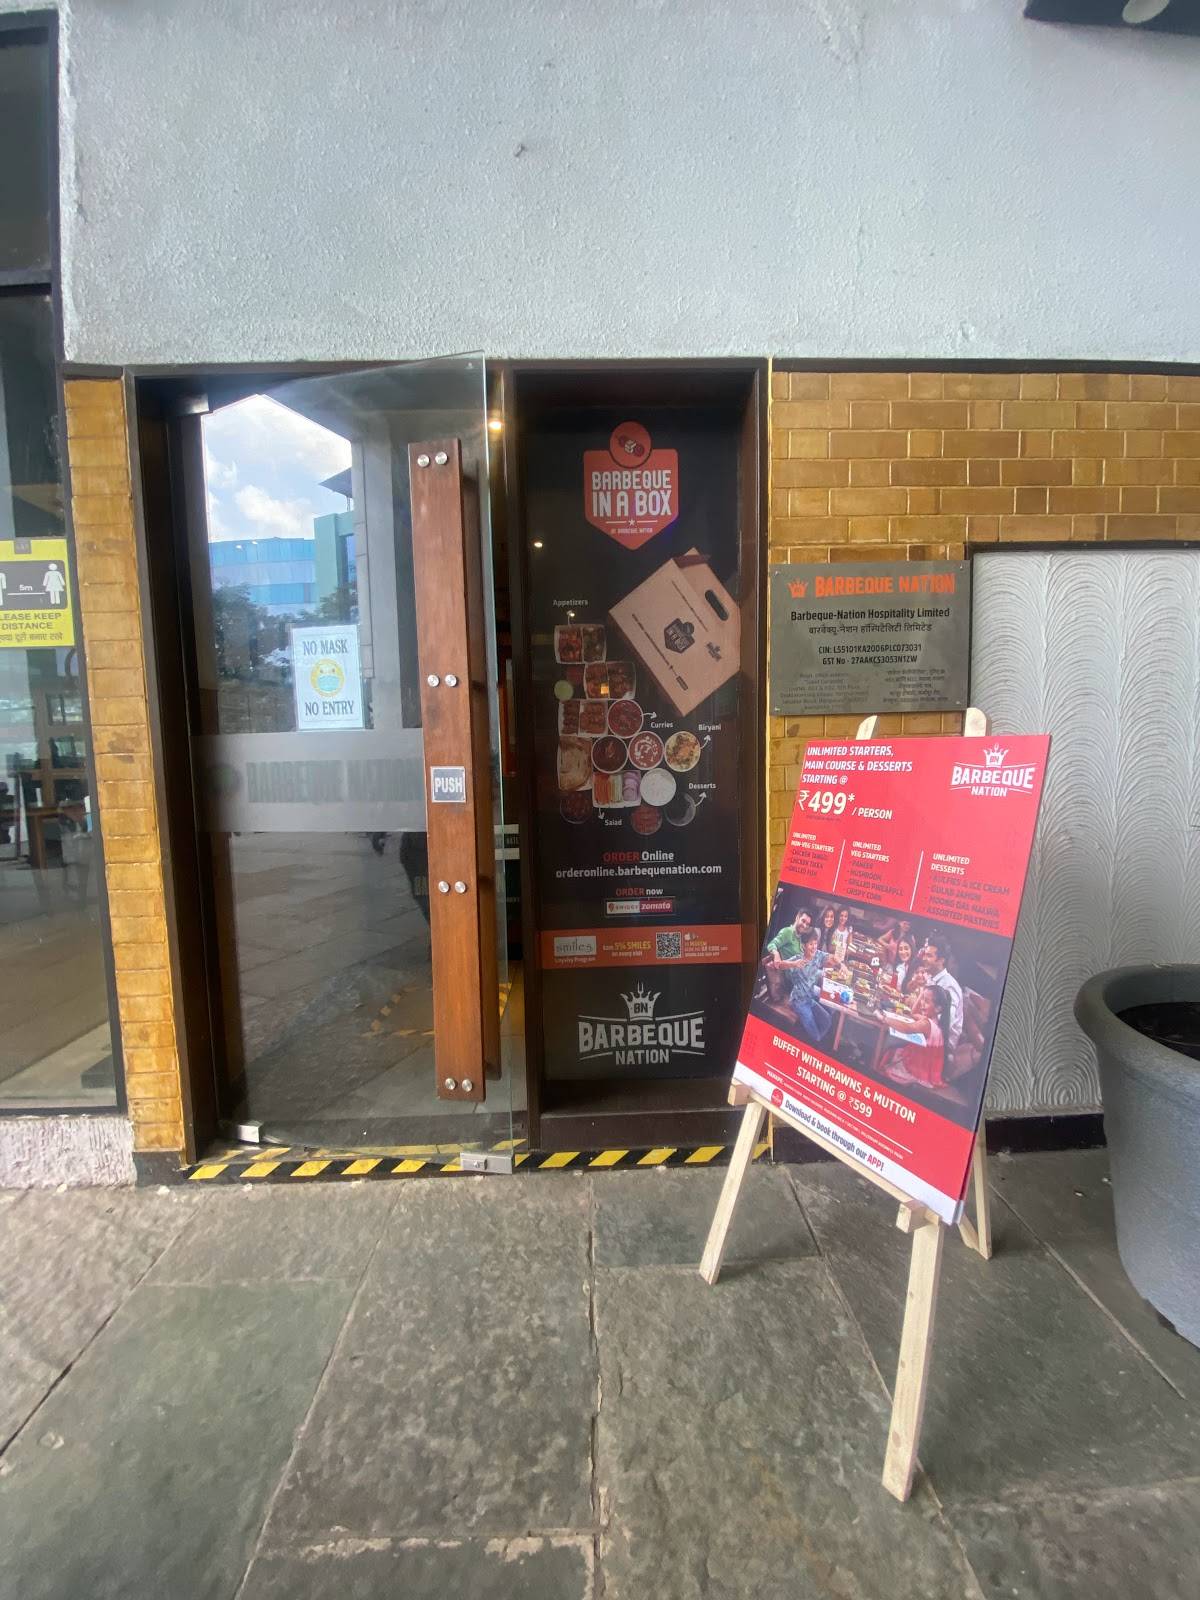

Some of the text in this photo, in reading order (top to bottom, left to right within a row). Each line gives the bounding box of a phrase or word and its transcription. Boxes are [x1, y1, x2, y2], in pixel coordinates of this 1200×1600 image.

[592, 470, 672, 490] BARBEQUE
[593, 490, 672, 517] IN A BOX
[19, 584, 33, 592] 5m
[815, 576, 894, 598] BARBEQUE
[899, 573, 956, 594] NATION
[552, 598, 589, 608] Appetizers
[34, 612, 62, 620] KEEP
[790, 608, 951, 622] Barbeque-Nation Hospitality Limited
[1, 621, 54, 631] DISTANCE
[302, 639, 349, 656] NO MASK
[818, 646, 831, 654] CIN:
[822, 657, 835, 665] GST
[836, 657, 846, 665] No
[305, 700, 355, 716] NO ENTRY
[650, 721, 674, 729] Curries
[698, 723, 722, 732] Biryani
[807, 746, 894, 757] UNLIMITED STARTERS,
[805, 761, 912, 772] MAIN COURSE & DESSERTS
[802, 774, 848, 785] STARTING @
[951, 766, 1035, 789] BARBEQUE
[434, 777, 463, 793] PUSH
[688, 781, 717, 790] Desserts
[971, 785, 1008, 797] NATION
[858, 807, 893, 820] PERSON
[604, 818, 623, 827] Salad
[792, 831, 817, 841] UNLIMITED
[811, 843, 835, 853] STARTERS
[852, 841, 882, 851] UNLIMITED
[603, 850, 674, 863] ORDER Online
[850, 850, 890, 863] VEG STARTERS
[932, 853, 970, 865] UNLIMITED
[556, 864, 722, 878] orderonline.barbequenation.com
[931, 863, 965, 875] DESSERTS
[616, 888, 663, 896] ORDER now
[641, 902, 671, 910] zomato
[556, 938, 592, 953] smiles
[633, 1003, 648, 1013] BN
[578, 1017, 705, 1053] BARBEQUE
[615, 1049, 670, 1065] NATION
[773, 1036, 800, 1058] BUFFET
[801, 1051, 823, 1071] WITH
[824, 1065, 862, 1093] PRAWNS
[864, 1087, 871, 1098] &
[873, 1092, 916, 1123] MUTTON
[796, 1066, 836, 1097] STARTING
[837, 1090, 846, 1100] @
[785, 1100, 812, 1124] Download
[811, 1117, 816, 1126] &
[816, 1120, 832, 1136] book
[831, 1128, 855, 1153] through
[855, 1147, 868, 1160] our
[867, 1154, 884, 1171] APP!
